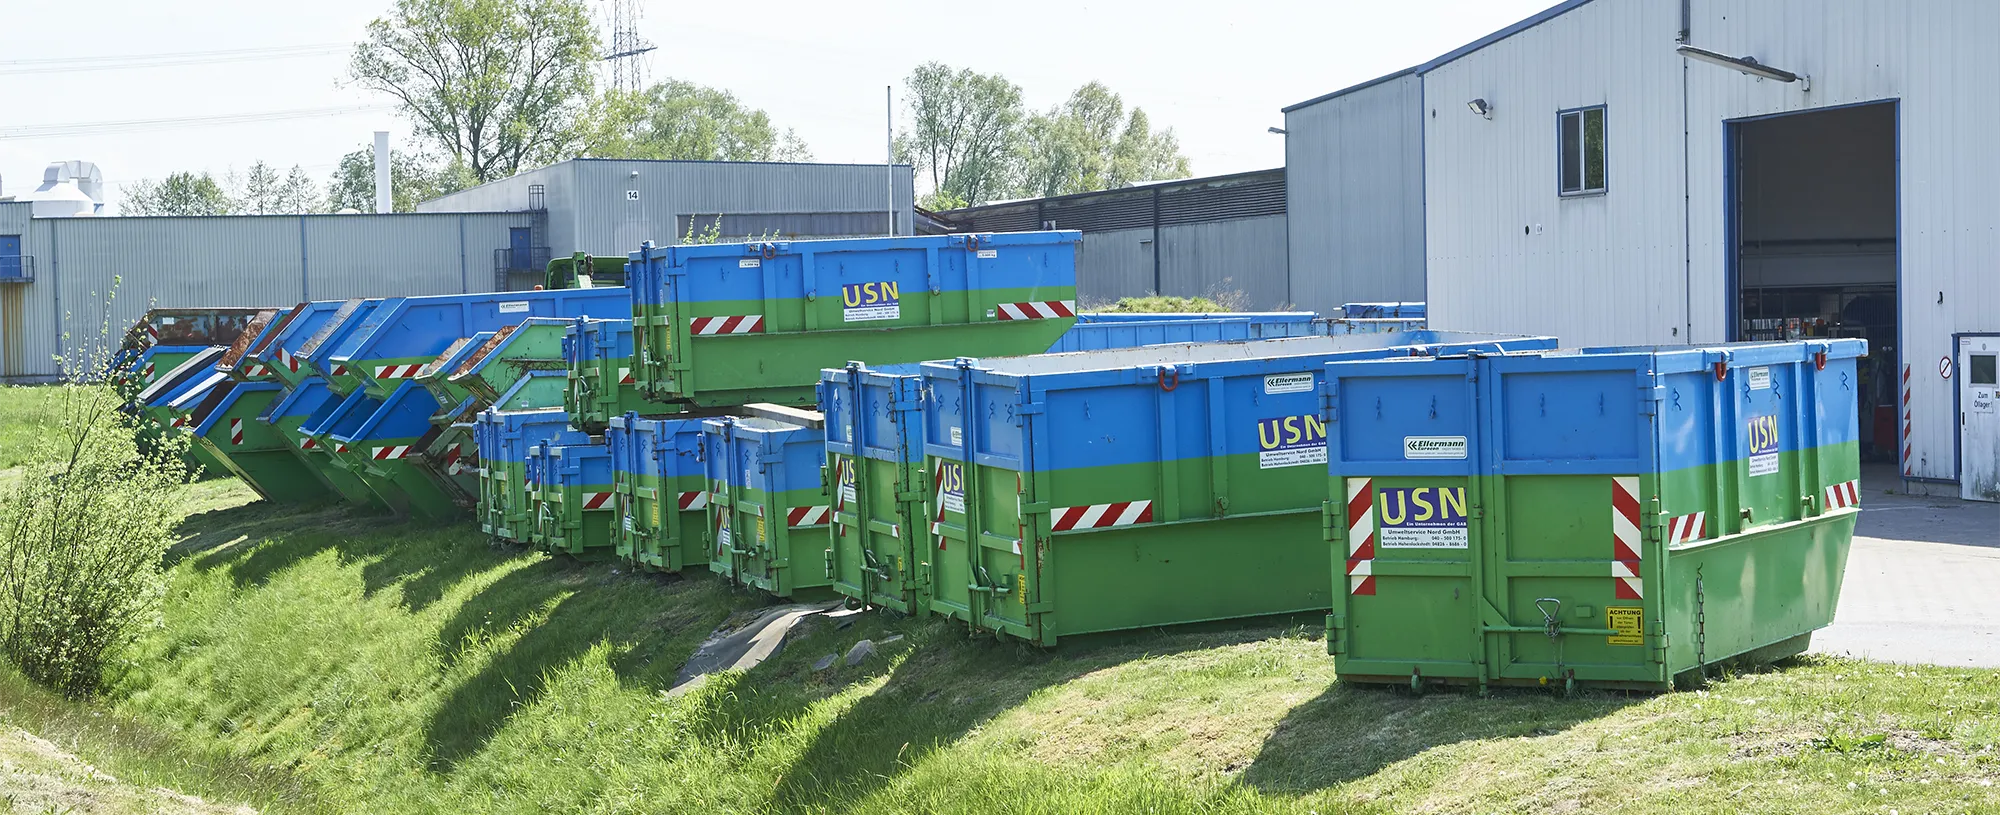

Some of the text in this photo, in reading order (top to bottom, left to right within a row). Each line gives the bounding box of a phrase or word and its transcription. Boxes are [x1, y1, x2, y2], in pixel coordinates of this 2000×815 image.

[628, 191, 638, 199] 14
[842, 281, 899, 307] USN
[1258, 414, 1327, 449] USN
[1748, 414, 1778, 454] USN
[943, 463, 964, 493] US
[1380, 488, 1467, 525] USN
